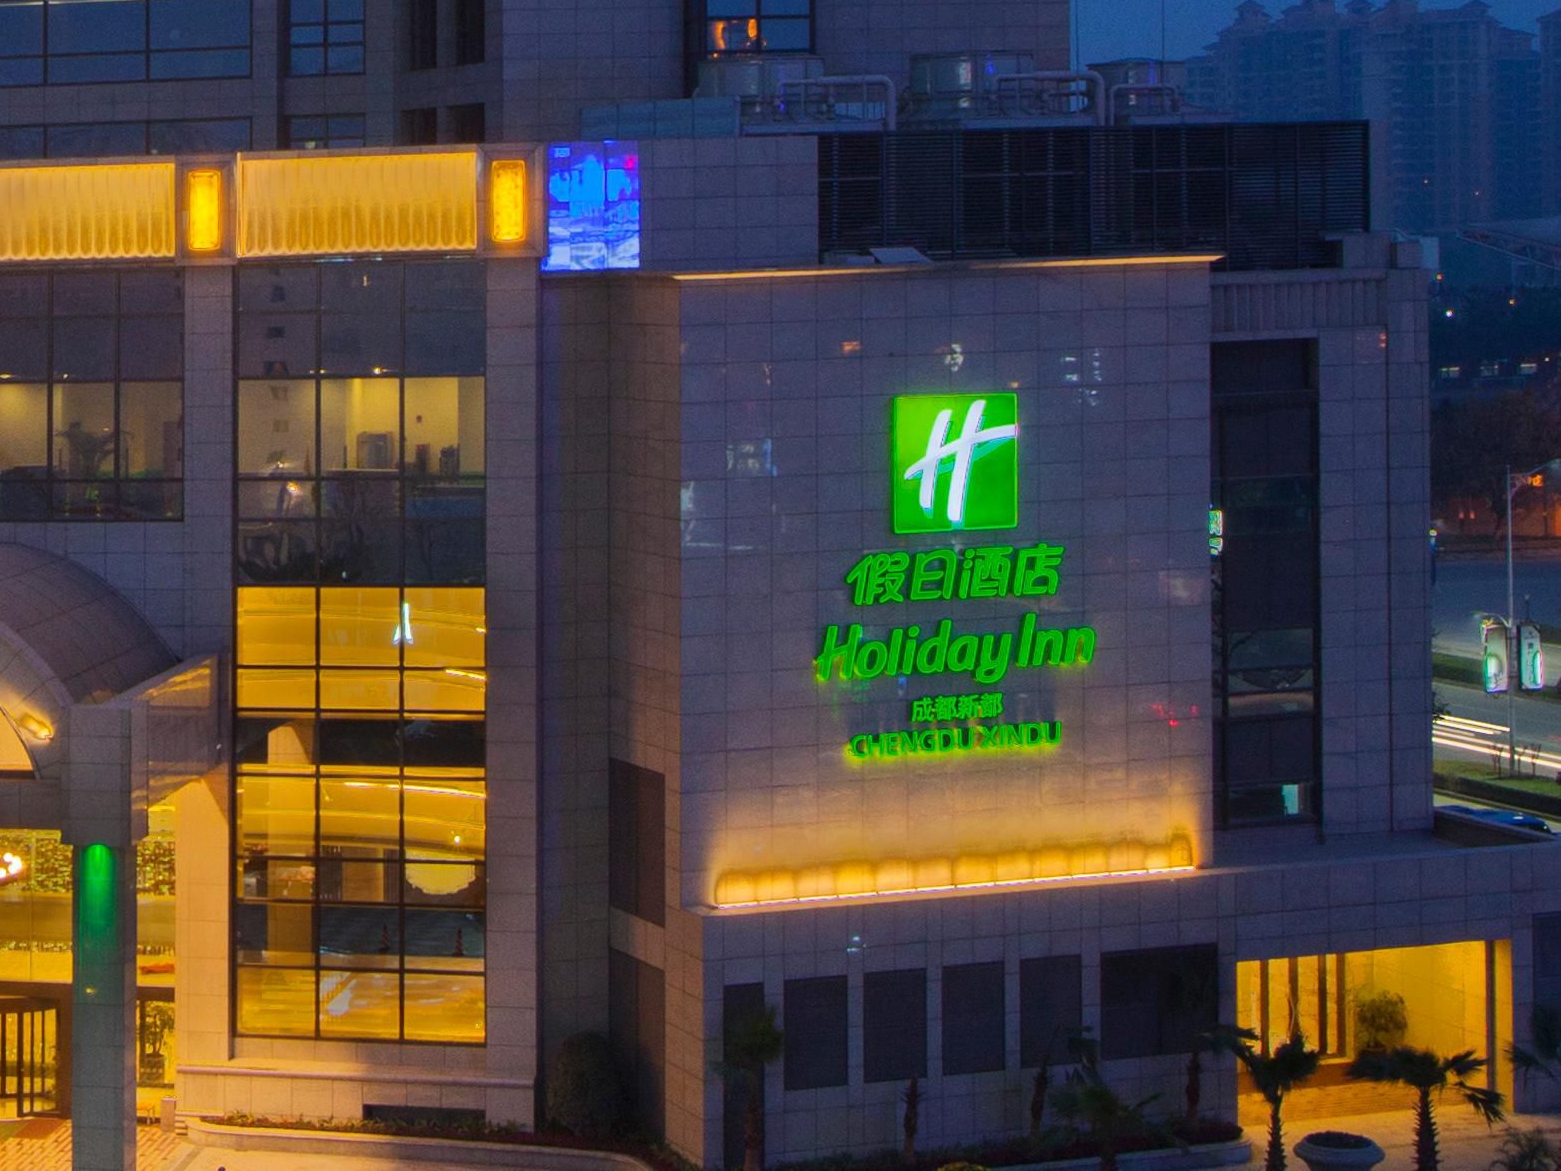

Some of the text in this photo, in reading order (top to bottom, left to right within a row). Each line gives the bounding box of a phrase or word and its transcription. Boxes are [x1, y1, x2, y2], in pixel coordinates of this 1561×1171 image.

[904, 400, 1019, 522] H
[846, 543, 1065, 606] 假日酒店
[814, 613, 1096, 685] Holiday Inn
[911, 692, 1004, 722] 成都新都
[848, 720, 1063, 759] CHENGDU XINDU
